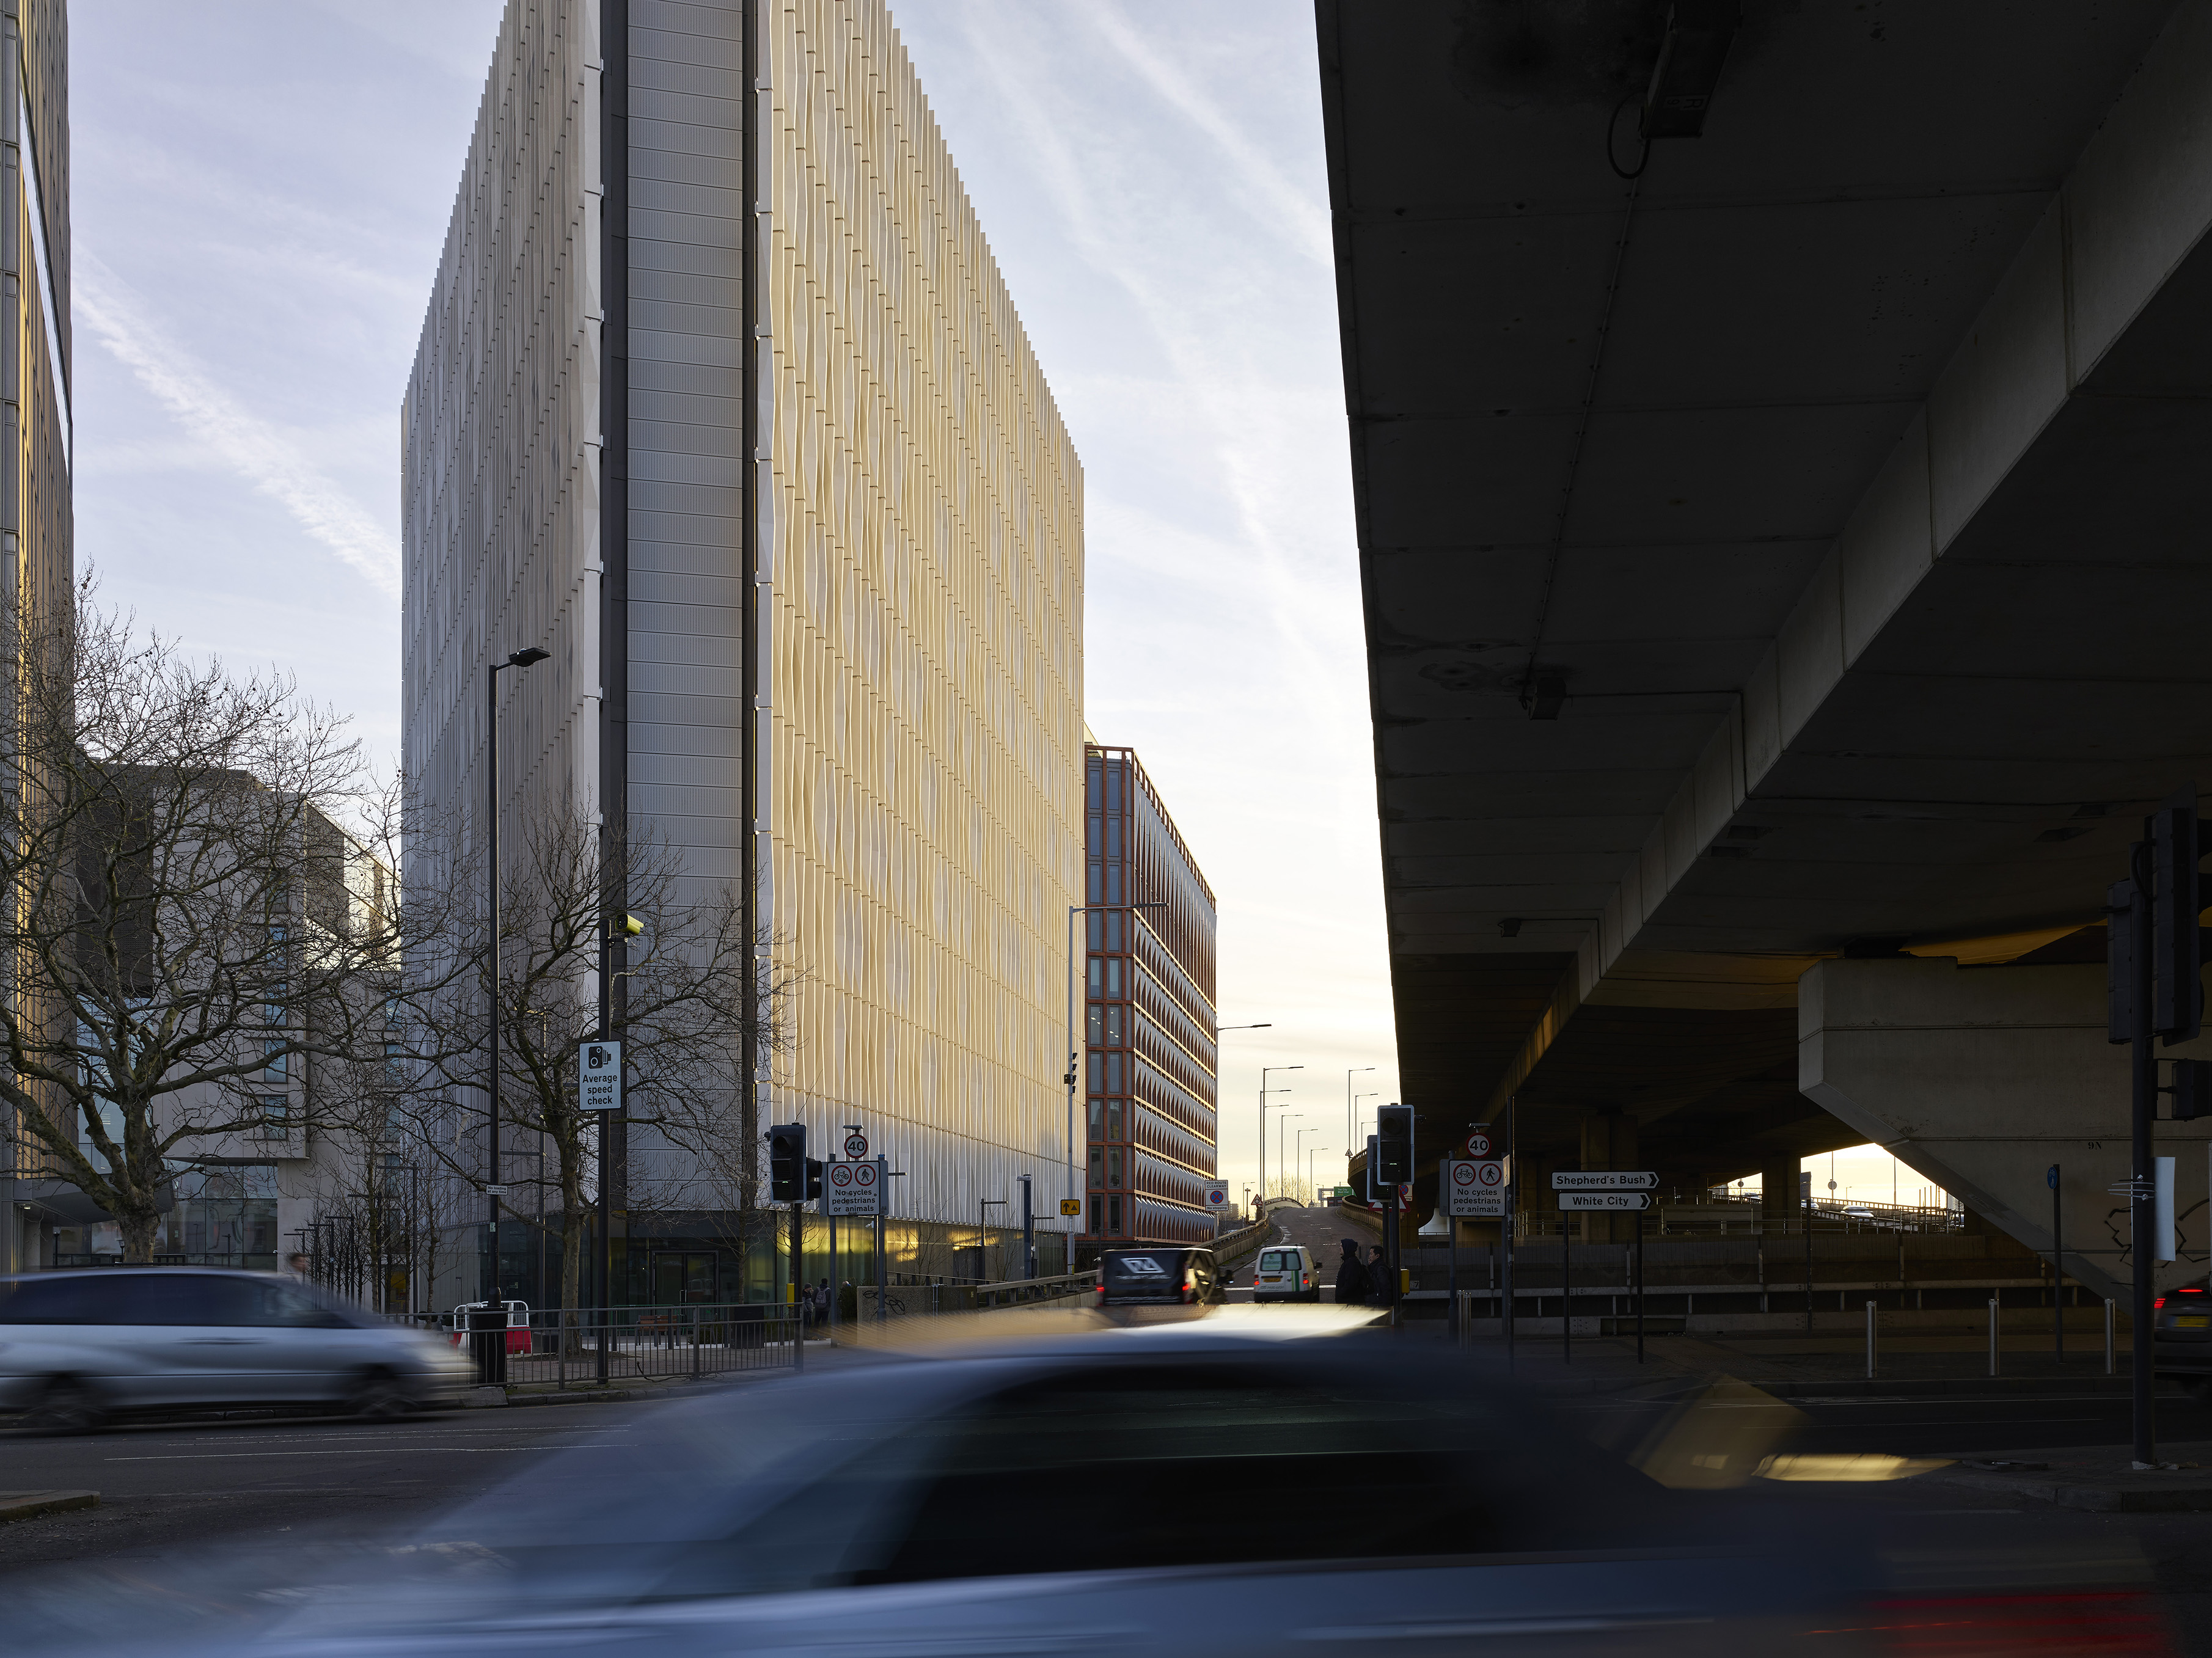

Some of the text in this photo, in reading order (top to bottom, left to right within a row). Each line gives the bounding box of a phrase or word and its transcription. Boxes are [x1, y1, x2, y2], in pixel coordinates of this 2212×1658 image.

[582, 1074, 618, 1083] Average
[587, 1084, 612, 1095] speed
[587, 1095, 613, 1105] check
[848, 1141, 865, 1152] 40
[1469, 1140, 1489, 1151] 40
[2088, 1141, 2101, 1150] 9N
[1556, 1175, 1646, 1186] Shepherd's Bush
[1471, 1188, 1497, 1197] cycles
[832, 1197, 876, 1205] pedestrians
[1572, 1196, 1629, 1207] White City
